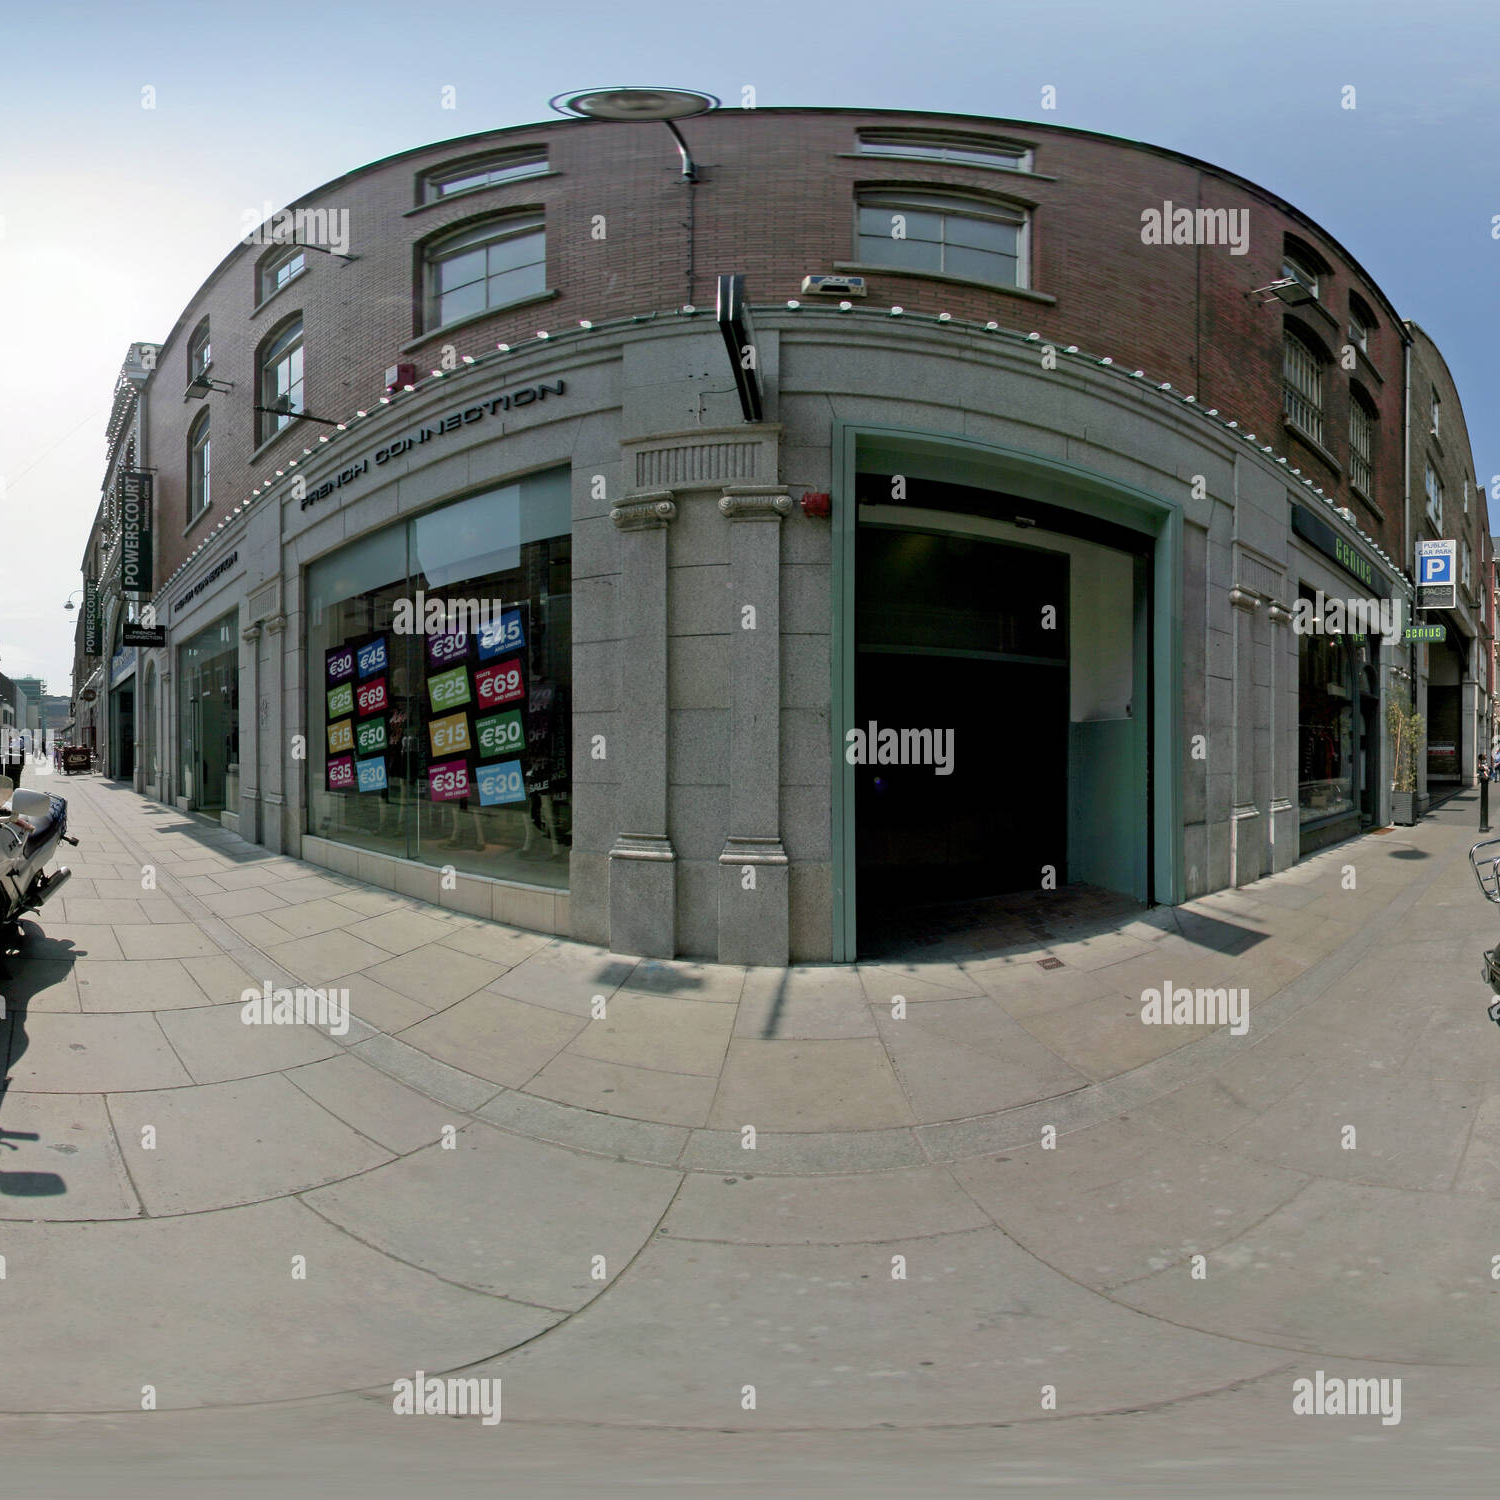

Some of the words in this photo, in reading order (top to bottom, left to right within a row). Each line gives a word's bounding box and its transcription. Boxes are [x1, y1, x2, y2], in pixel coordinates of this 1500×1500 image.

[301, 459, 368, 511] FRENCH
[375, 379, 564, 466] CONNECTION
[124, 476, 139, 586] POWERSCOURT
[1426, 558, 1446, 580] P
[86, 582, 96, 653] POWERSCOURT
[432, 631, 467, 657] €30
[329, 654, 352, 675] €30
[360, 646, 385, 669] €45
[433, 676, 466, 702] €25
[480, 670, 520, 697] €69
[330, 690, 351, 710] €25
[359, 686, 384, 707] €69
[330, 727, 351, 746] €15
[359, 726, 385, 746] €50
[434, 723, 466, 747] €15
[480, 721, 520, 747] €50
[329, 763, 352, 781] €35
[361, 766, 385, 784] €30
[432, 769, 467, 792] €35
[481, 772, 520, 795] €30
